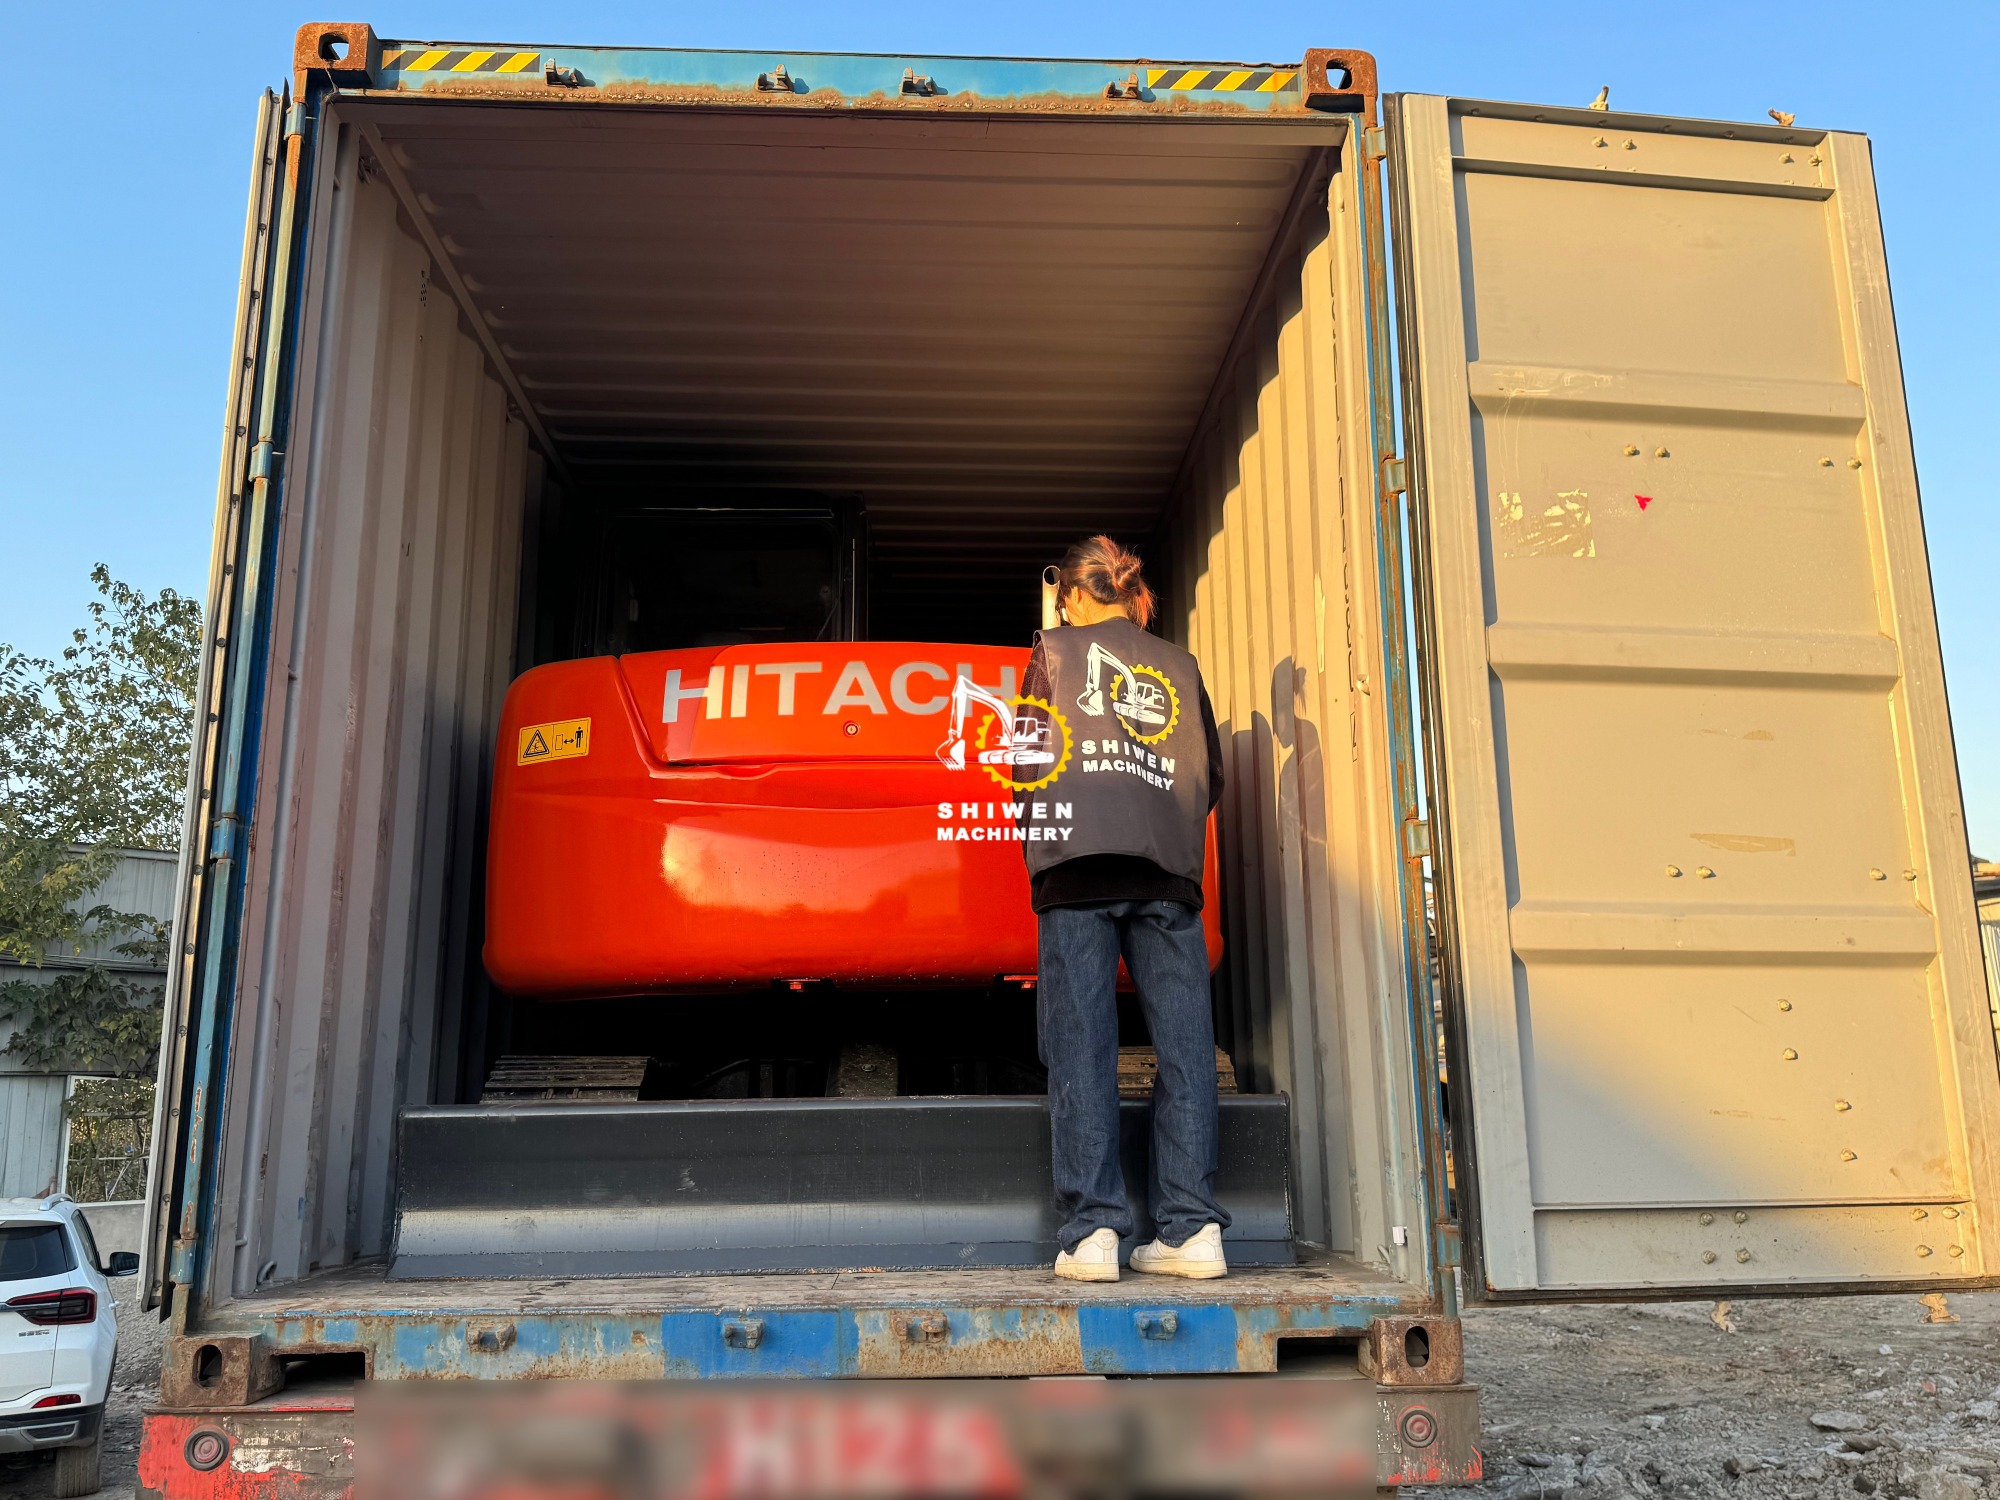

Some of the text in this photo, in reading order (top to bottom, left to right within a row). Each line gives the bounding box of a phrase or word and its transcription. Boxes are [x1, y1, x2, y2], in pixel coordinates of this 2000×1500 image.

[662, 661, 1026, 723] HITACH
[1081, 739, 1176, 774] SHIWEN
[1082, 758, 1175, 791] MACHINERY
